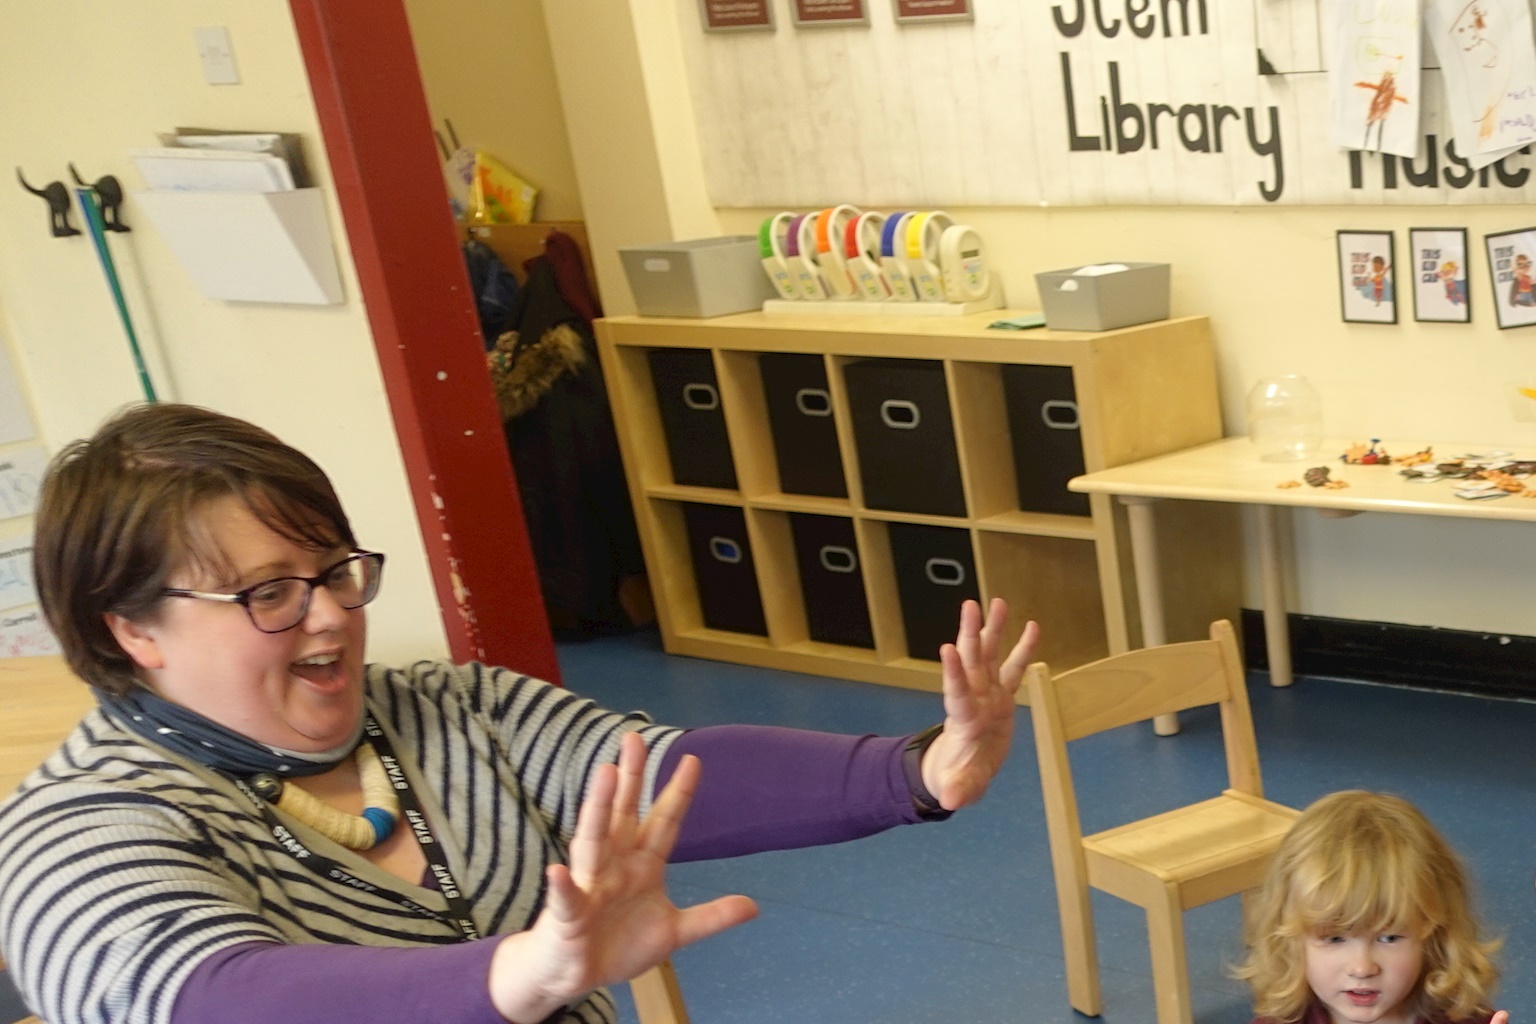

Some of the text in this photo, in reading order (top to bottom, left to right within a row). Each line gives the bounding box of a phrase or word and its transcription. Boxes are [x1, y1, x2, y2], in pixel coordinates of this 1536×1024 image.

[1059, 51, 1284, 202] Library
[381, 755, 408, 790] STAFF
[272, 825, 312, 859] STAFF
[405, 809, 434, 844] STAFF
[329, 869, 378, 892] STAFF
[431, 863, 460, 899] STAFF
[459, 919, 479, 942] AFF
